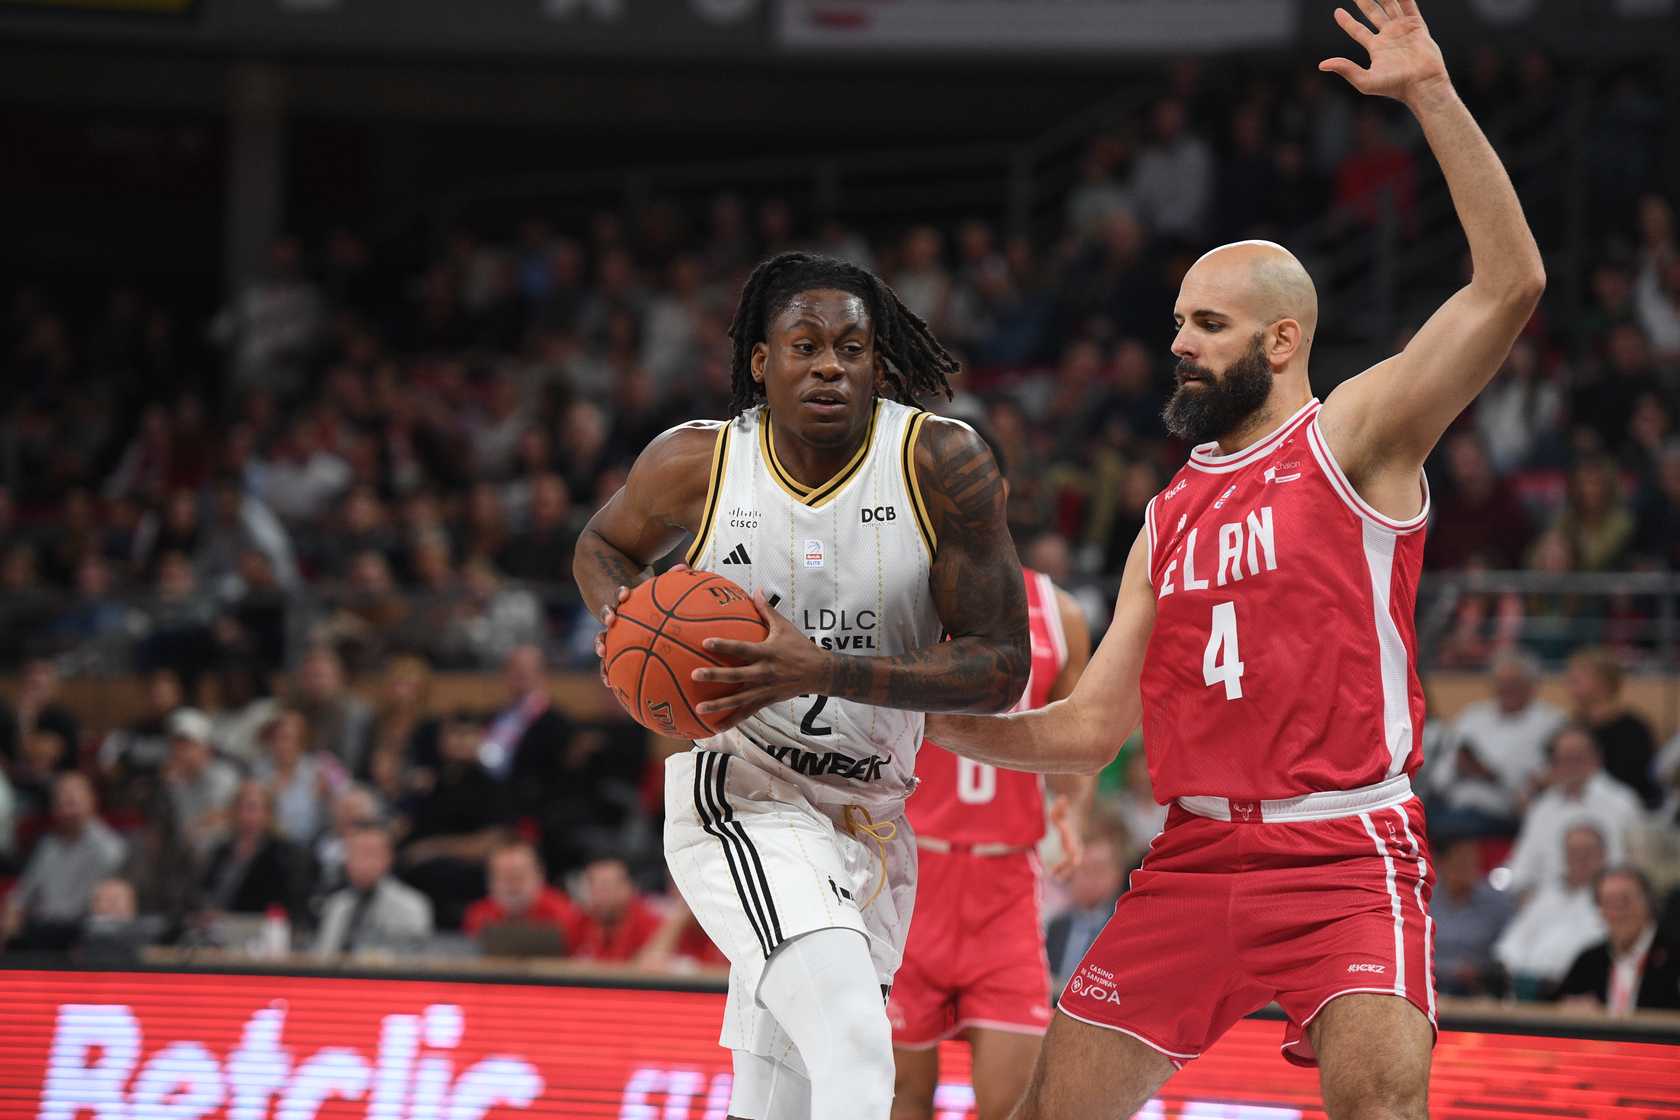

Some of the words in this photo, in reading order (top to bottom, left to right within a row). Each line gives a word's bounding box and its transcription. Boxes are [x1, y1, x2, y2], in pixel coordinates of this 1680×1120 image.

[730, 519, 758, 528] CISCO
[861, 506, 896, 523] DCB
[804, 609, 877, 631] LDLC
[1202, 601, 1244, 701] 4
[798, 693, 832, 735] 2
[1089, 964, 1114, 980] CASINO
